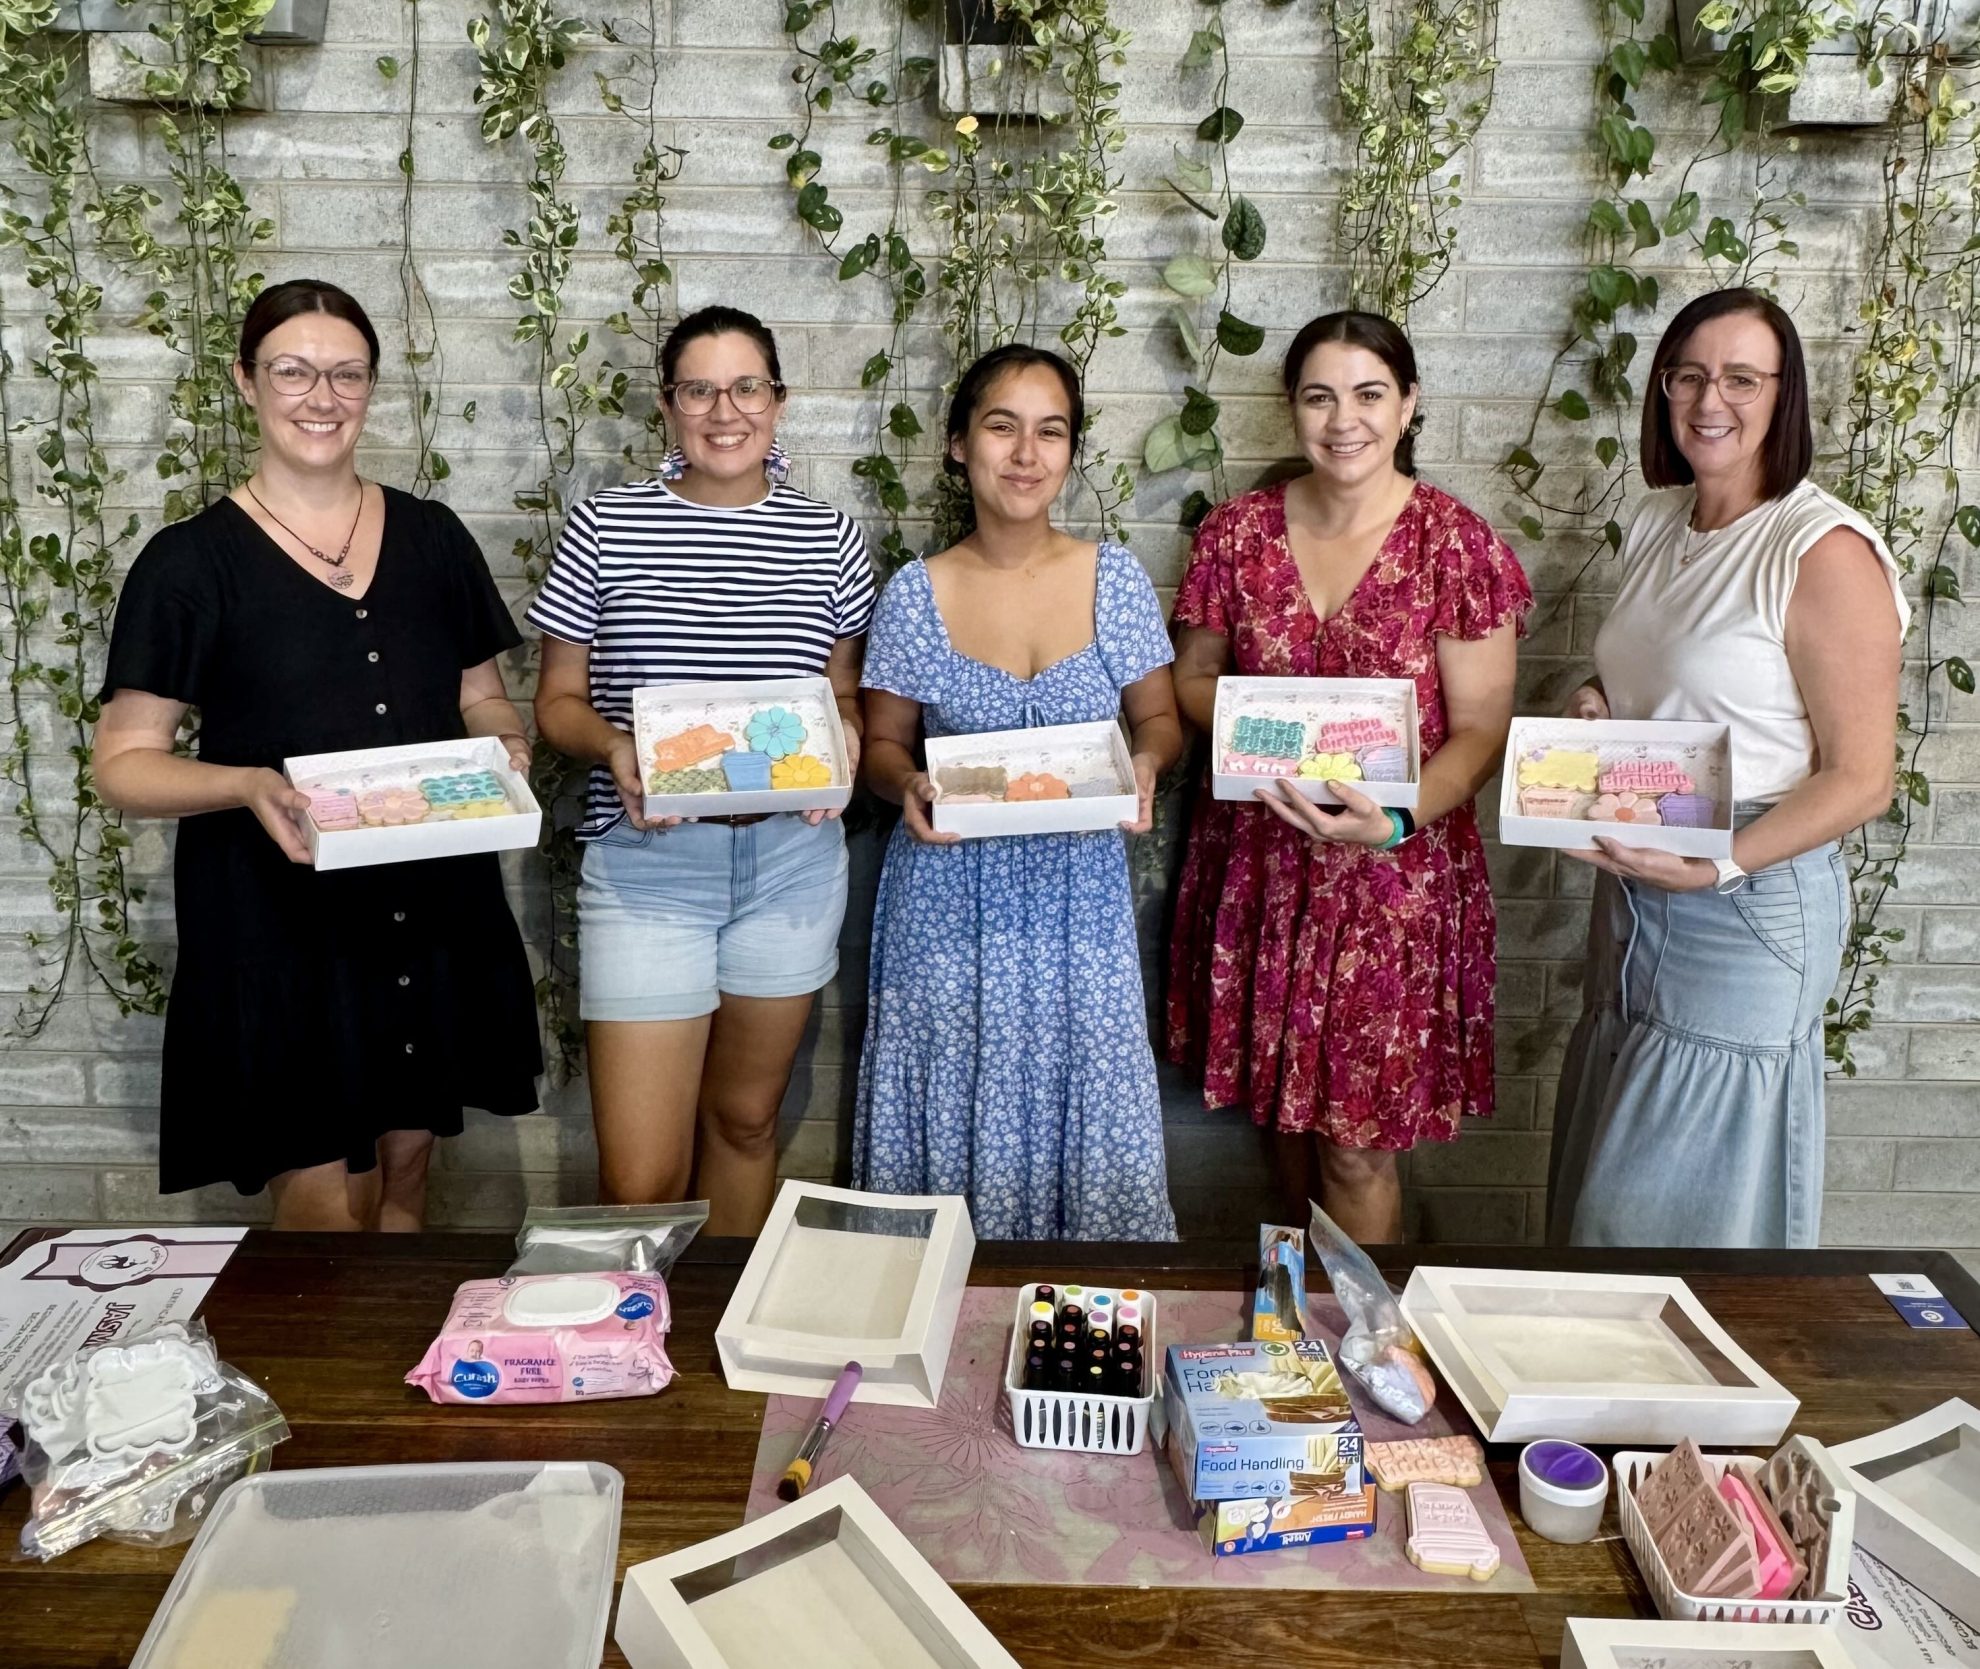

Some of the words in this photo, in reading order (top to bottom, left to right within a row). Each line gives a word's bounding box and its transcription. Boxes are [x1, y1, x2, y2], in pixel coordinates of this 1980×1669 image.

[1318, 729, 1398, 751] Birthday
[1295, 1341, 1320, 1351] 24
[1183, 1349, 1227, 1360] Hygiene
[504, 1358, 557, 1367] FRAGRANCE
[520, 1367, 542, 1376] FREE
[1184, 1365, 1236, 1380] Food
[453, 1372, 497, 1384] Curash
[1187, 1381, 1215, 1393] Ha
[1339, 1437, 1359, 1451] 24
[1201, 1458, 1237, 1472] Food
[1241, 1457, 1304, 1472] Handling
